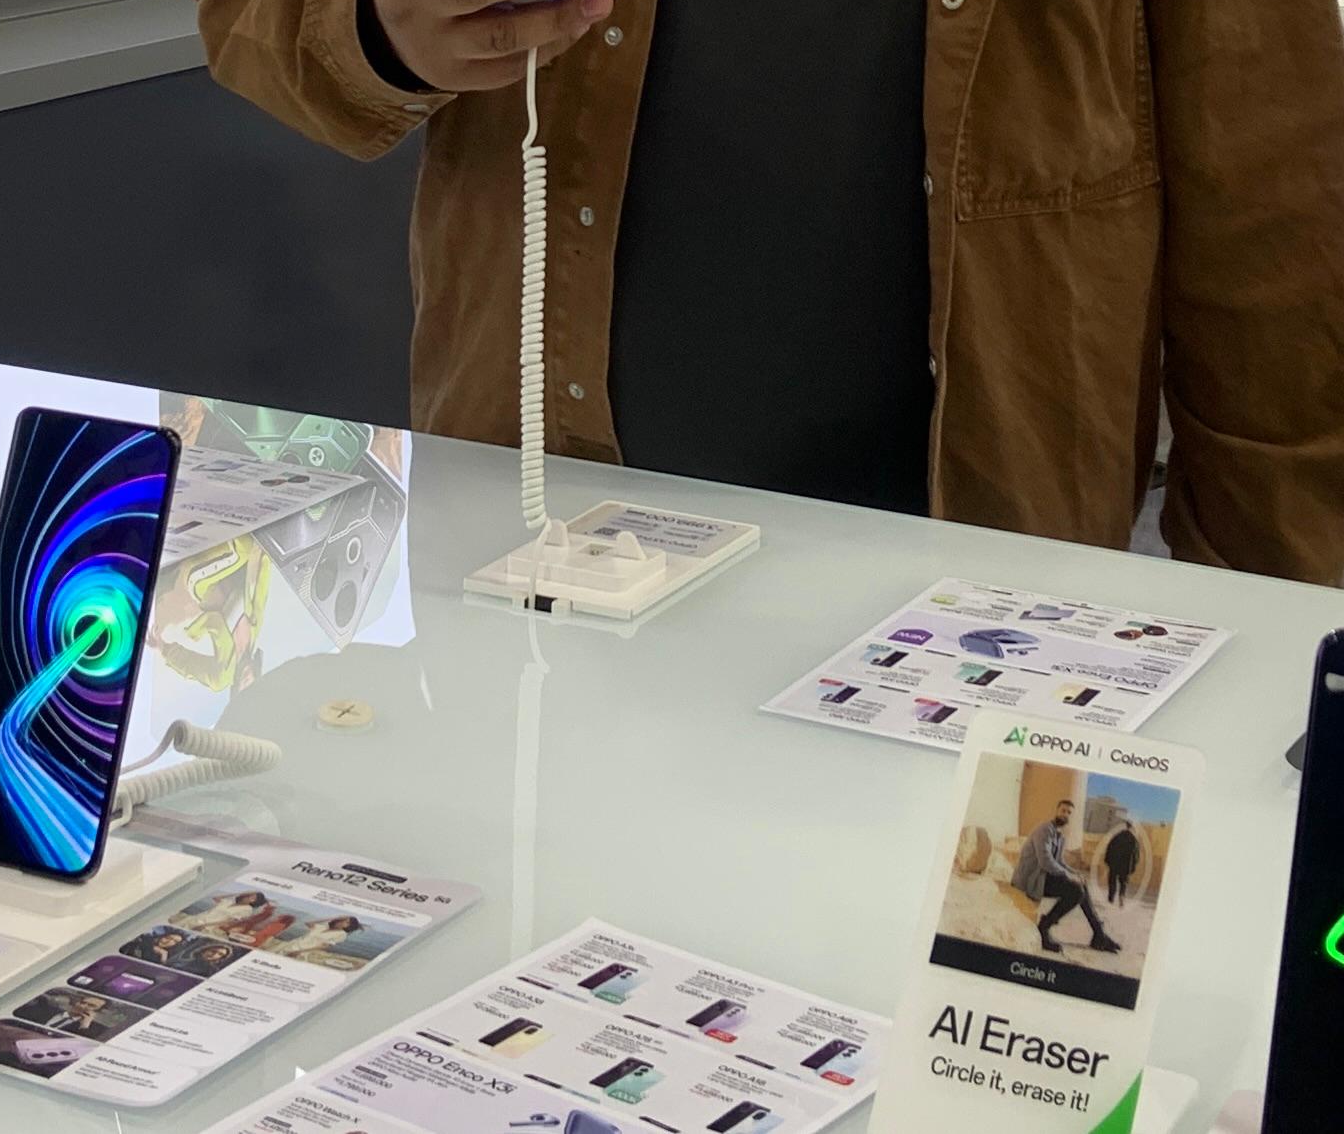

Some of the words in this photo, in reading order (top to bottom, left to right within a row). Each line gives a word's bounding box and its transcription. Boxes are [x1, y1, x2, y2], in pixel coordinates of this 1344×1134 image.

[1029, 733, 1072, 753] OPPO
[1074, 742, 1091, 757] AI
[1110, 749, 1170, 772] ColorOS
[292, 860, 367, 888] Reno12
[367, 878, 430, 904] Series
[1010, 961, 1045, 982] Circle
[1047, 970, 1057, 984] it
[393, 1041, 444, 1066] OPPO
[928, 1004, 973, 1046] AI
[979, 1014, 1110, 1078] Eraser
[931, 1055, 986, 1086] Circle
[989, 1069, 1006, 1095] it,
[1011, 1080, 1066, 1107] erase
[1070, 1089, 1091, 1113] it!
